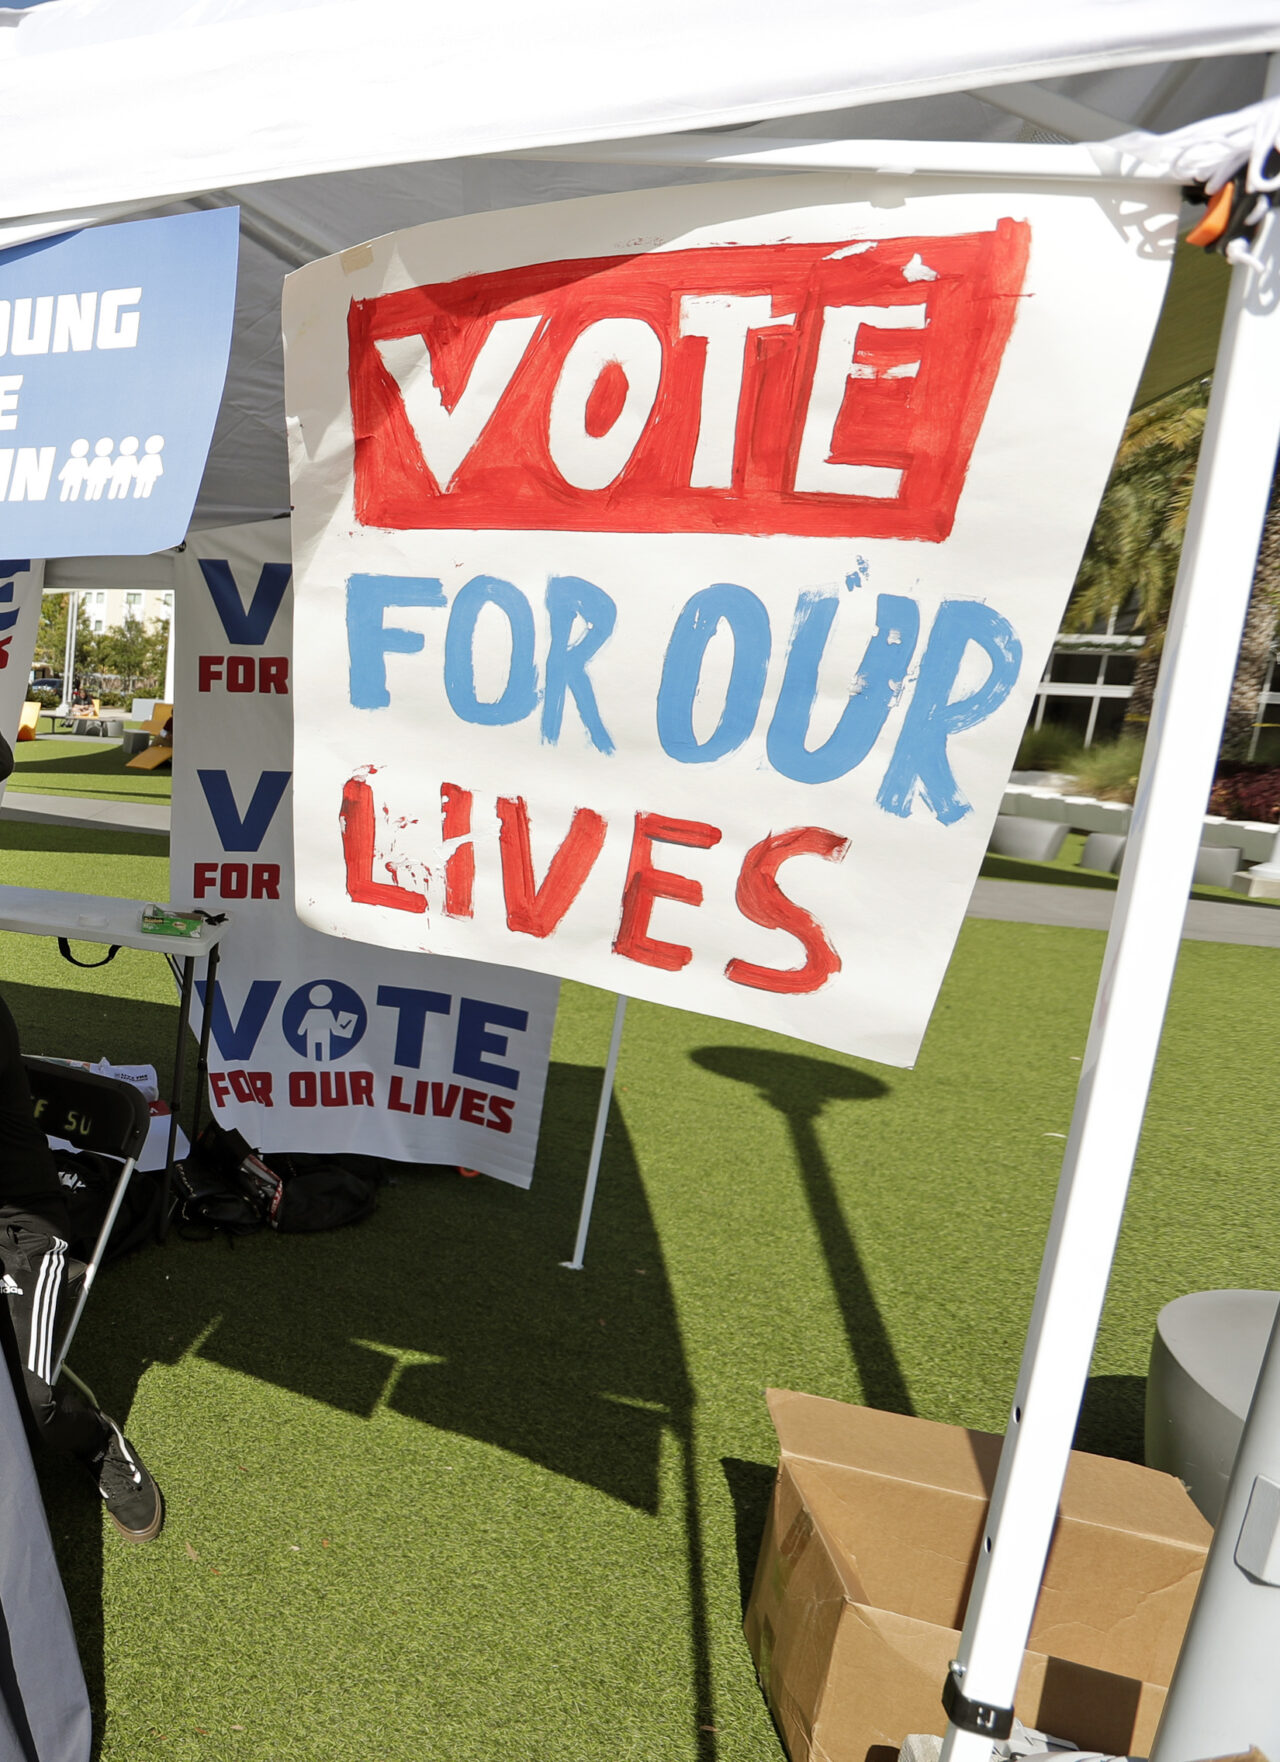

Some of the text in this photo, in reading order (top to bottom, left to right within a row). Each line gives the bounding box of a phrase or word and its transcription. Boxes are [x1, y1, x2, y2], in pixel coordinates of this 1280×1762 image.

[372, 293, 927, 500] VOTE
[198, 656, 289, 694] FOR
[344, 572, 1023, 826] FOR OUR
[193, 862, 280, 899] FOR
[340, 768, 852, 995] LIVES
[194, 979, 529, 1091] VOTE
[208, 1070, 516, 1134] FOR OUR LIVES
